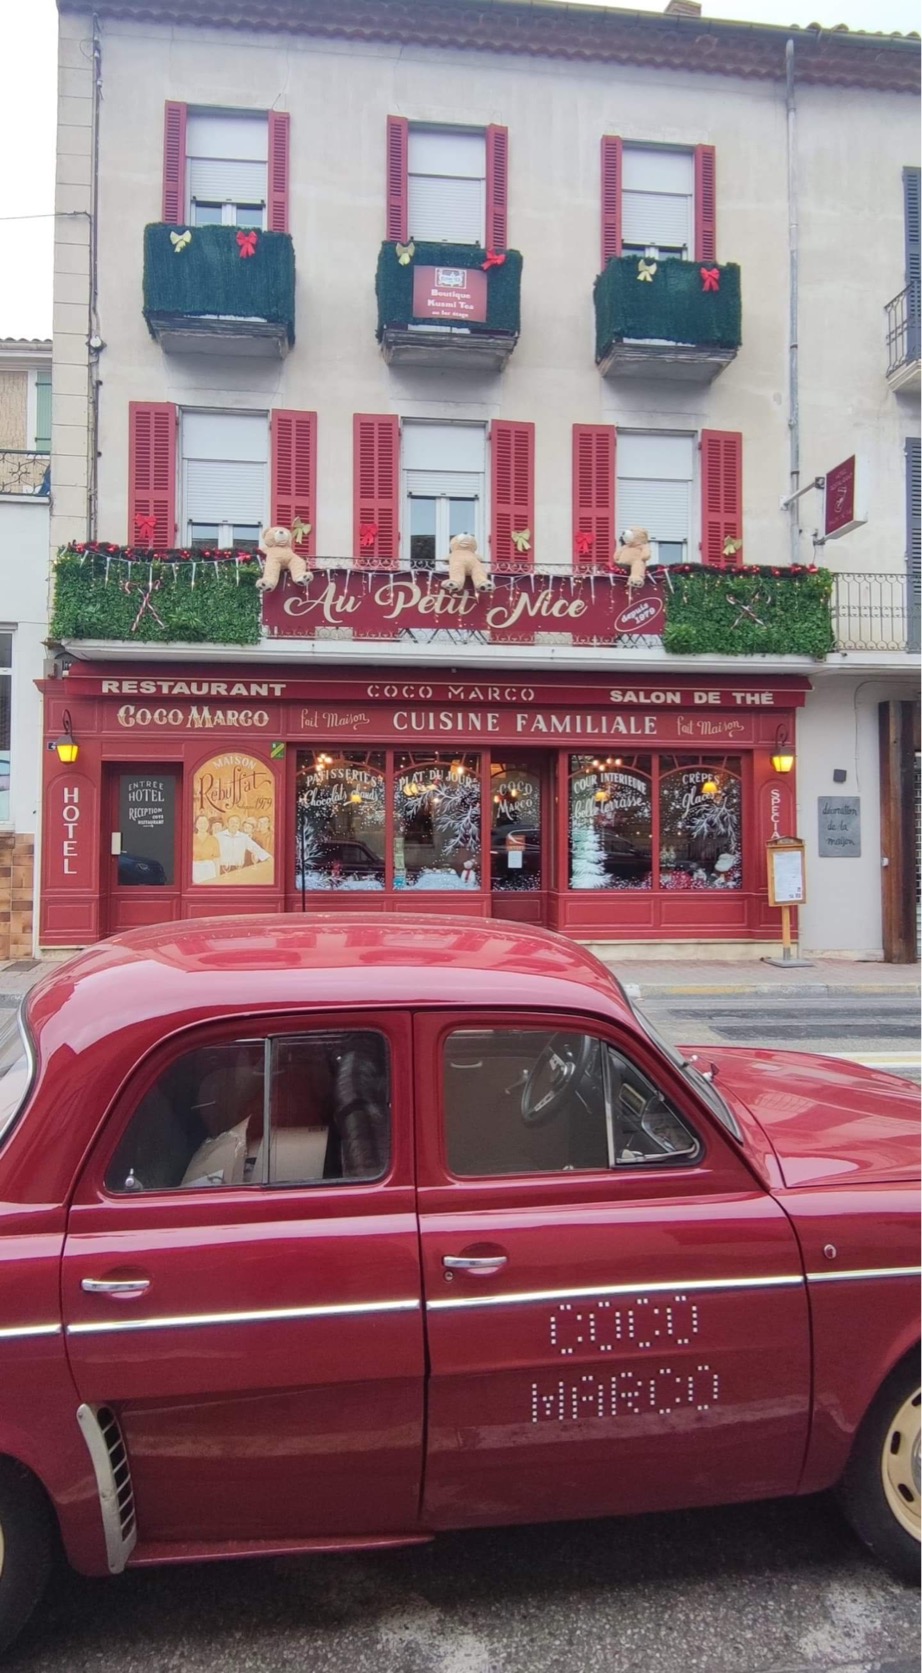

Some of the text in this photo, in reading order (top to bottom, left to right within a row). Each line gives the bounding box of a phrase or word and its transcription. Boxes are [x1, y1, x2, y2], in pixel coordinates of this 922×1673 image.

[431, 289, 471, 300] Boutique
[427, 299, 474, 310] Kusmi Tea
[284, 582, 588, 629] Au Petit Nice
[621, 602, 650, 623] depuis
[635, 607, 656, 625] 1979
[101, 680, 287, 697] RESTAURANT
[366, 684, 535, 701] COCO MARCO
[609, 689, 681, 704] SALON
[693, 691, 721, 704] DE
[116, 704, 270, 728] COCO MARCO
[322, 712, 370, 731] Maison
[393, 711, 657, 735] CUISINE FAMILIALE
[696, 719, 745, 738] Maison
[213, 756, 257, 769] MAISON
[399, 769, 473, 791] PLAT DU JOUR
[574, 772, 647, 795] COUR INTERIEURE
[682, 771, 720, 785] CRÊPES
[128, 788, 165, 802] HOTEL
[199, 766, 271, 813] Rebuffat
[499, 780, 533, 796] COCO
[254, 796, 273, 811] 1979
[497, 799, 533, 820] MARCO
[128, 807, 163, 821] RECEPTION
[62, 787, 80, 874] HOTEL
[827, 820, 849, 831] de la
[550, 1295, 698, 1354] COCO
[532, 1365, 719, 1422] MARCO
